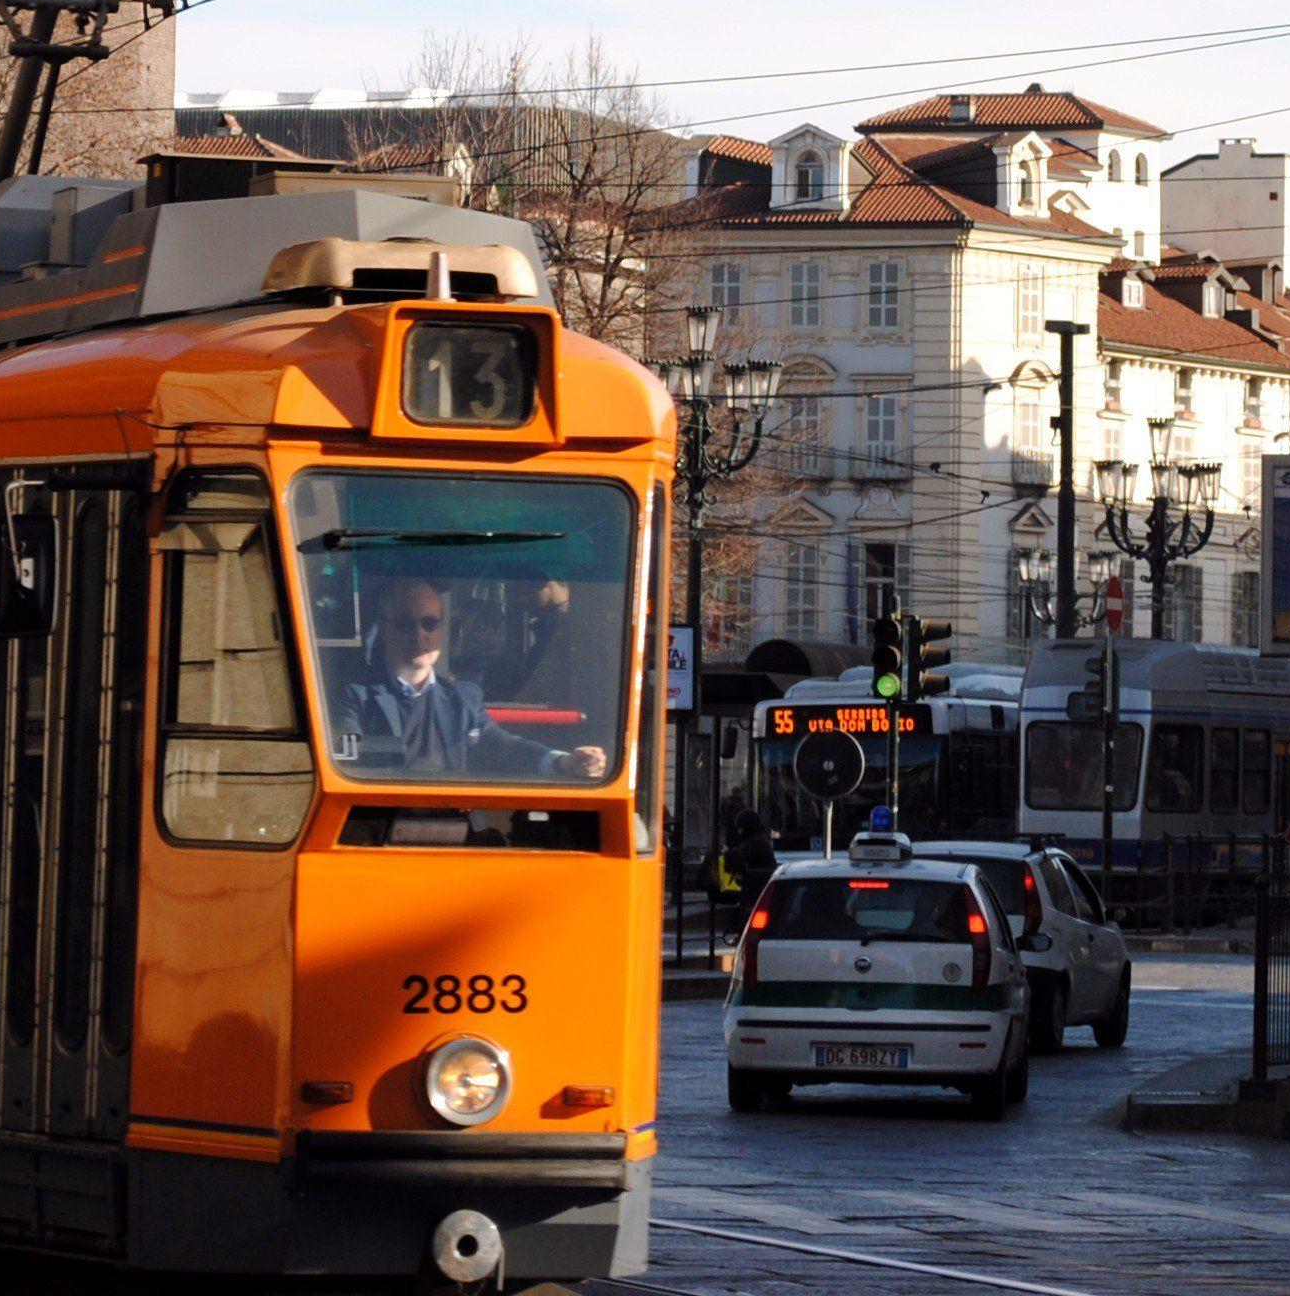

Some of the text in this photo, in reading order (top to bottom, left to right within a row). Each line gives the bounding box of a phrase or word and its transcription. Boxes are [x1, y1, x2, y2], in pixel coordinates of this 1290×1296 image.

[427, 340, 507, 419] 13
[774, 708, 794, 734] 55
[871, 717, 915, 733] BOIO
[402, 974, 528, 1014] 2883
